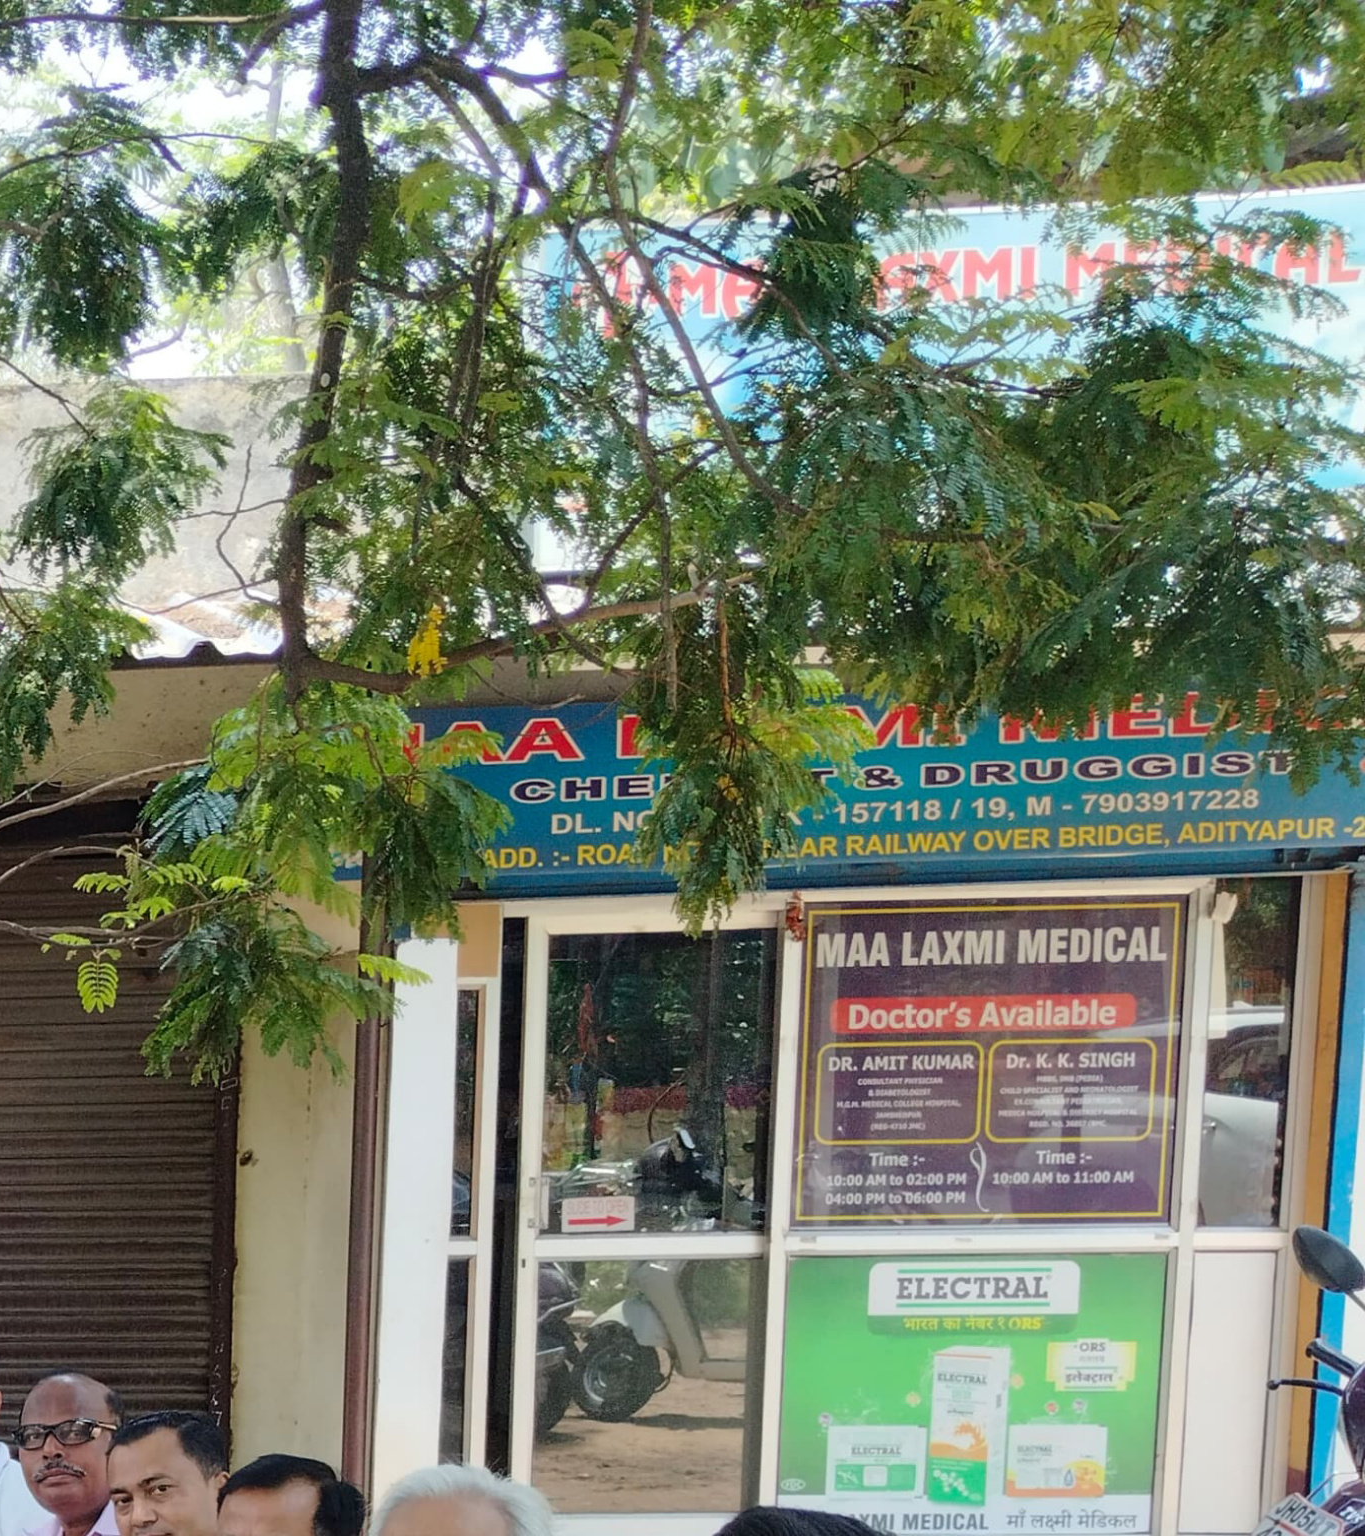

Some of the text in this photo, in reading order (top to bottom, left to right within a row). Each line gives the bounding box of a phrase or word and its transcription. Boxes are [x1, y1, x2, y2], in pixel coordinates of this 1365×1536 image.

[854, 764, 903, 791] &
[551, 813, 601, 835] DL.
[834, 800, 942, 825] 157118
[971, 797, 1015, 821] 19,
[1027, 796, 1052, 817] M
[1081, 789, 1260, 814] 7903917228
[482, 847, 543, 869] ADD.
[846, 831, 967, 857] RAILWAY
[974, 827, 1050, 851] OVER
[1058, 822, 1170, 848] BRIDGE,
[1177, 817, 1335, 844] ADITYAPUR
[816, 926, 1168, 968] MAA LAXMI MEDICAL
[848, 1000, 1117, 1030] Doctor's Available
[829, 1053, 975, 1071] DR. AMIT KUMAR
[1006, 1052, 1136, 1069] Dr. K. K. SINGH
[869, 1153, 908, 1167] Time
[1036, 1151, 1075, 1165] Time
[827, 1173, 967, 1187] 10:00 AM to 02:00 PM
[992, 1171, 1134, 1185] 10:00 AM to 11:00 AM
[826, 1191, 966, 1206] 04:00 PM to 06:00 PM
[896, 1276, 1048, 1300] ELECTRAL
[902, 1316, 939, 1331] भारत
[942, 1316, 962, 1331] का
[1008, 1317, 1042, 1330] ORS
[1079, 1342, 1106, 1353] ORS
[937, 1372, 988, 1385] ELECTRAL
[851, 1446, 902, 1456] ELECTRAL
[902, 1513, 989, 1530] MEDICAL
[1007, 1508, 1137, 1531] माँ लक्ष्मी मेडिकल
